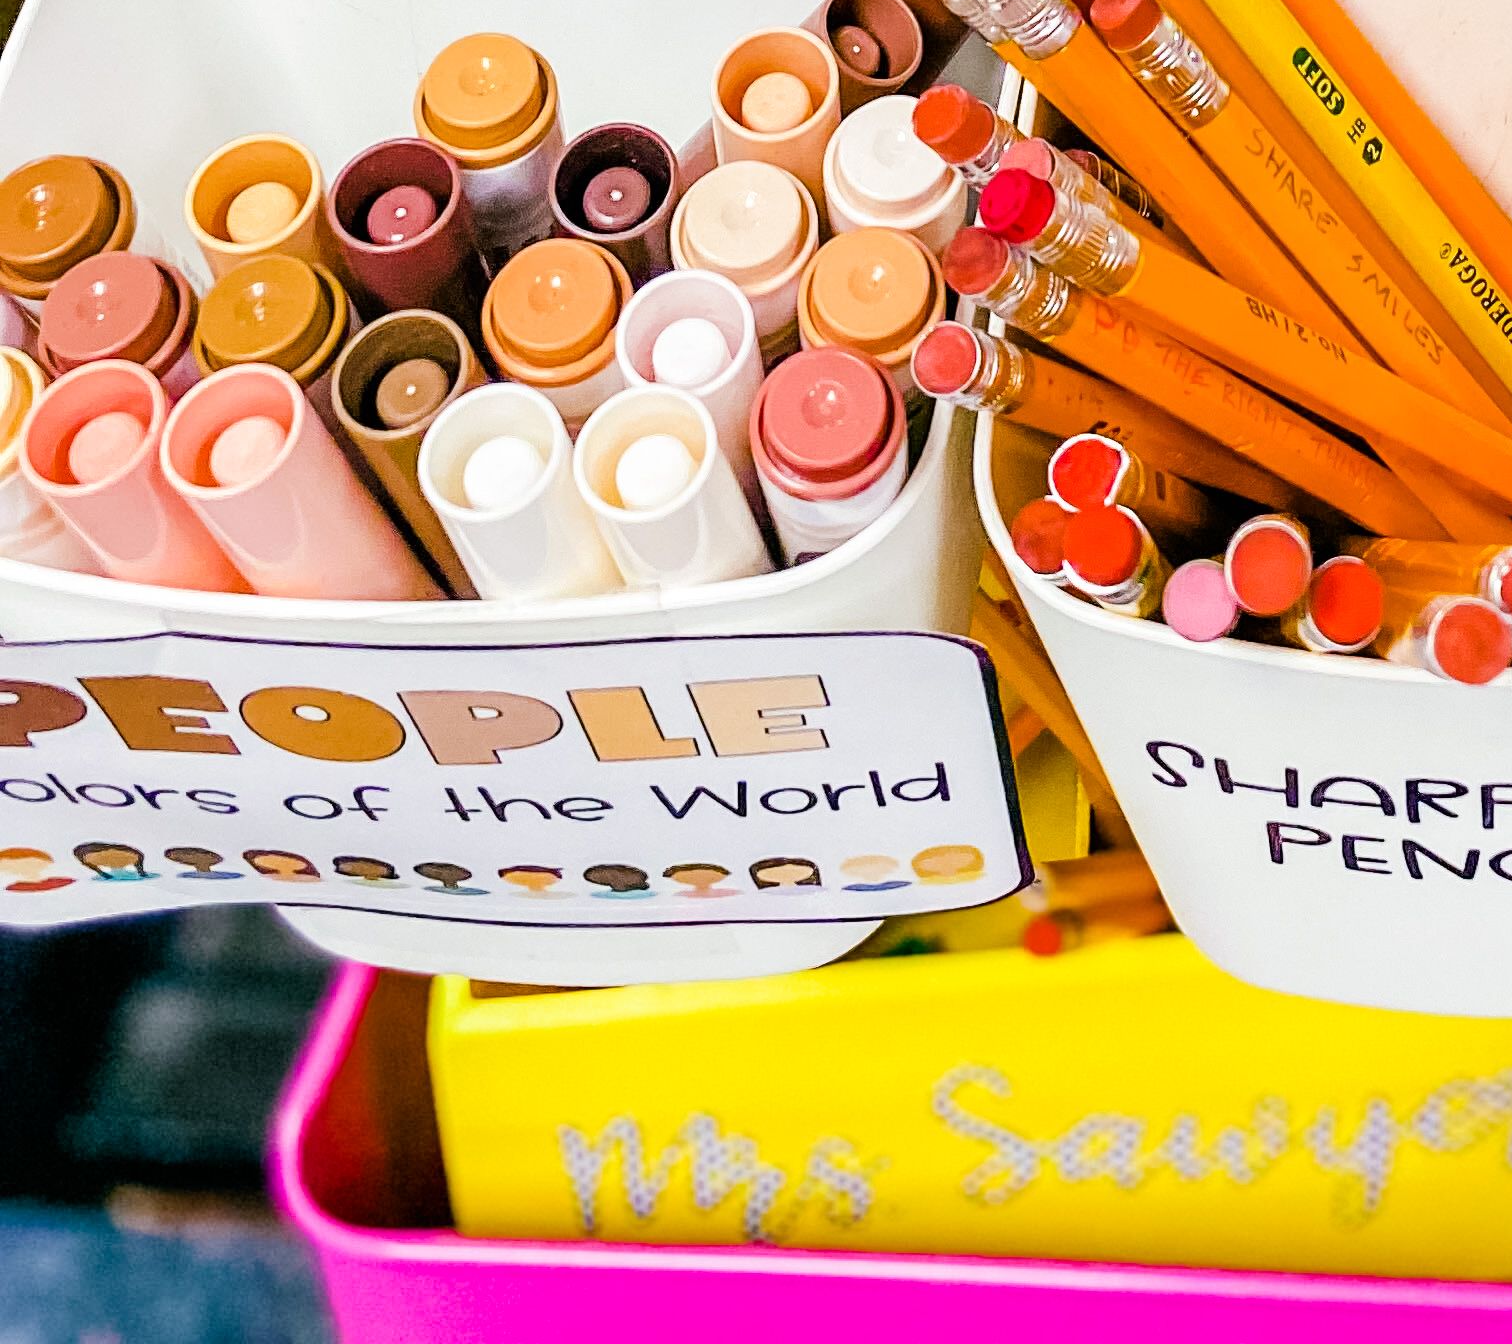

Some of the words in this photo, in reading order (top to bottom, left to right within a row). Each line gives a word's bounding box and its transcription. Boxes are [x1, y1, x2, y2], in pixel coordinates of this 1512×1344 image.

[1297, 55, 1342, 111] SOFT
[1346, 117, 1367, 144] HB
[1245, 128, 1338, 234] SHARE
[0, 674, 831, 765] PEOPLE
[0, 773, 240, 815] olors
[283, 786, 391, 822] of
[444, 785, 615, 823] the
[649, 762, 952, 820] World
[555, 1108, 878, 1245] Mrs
